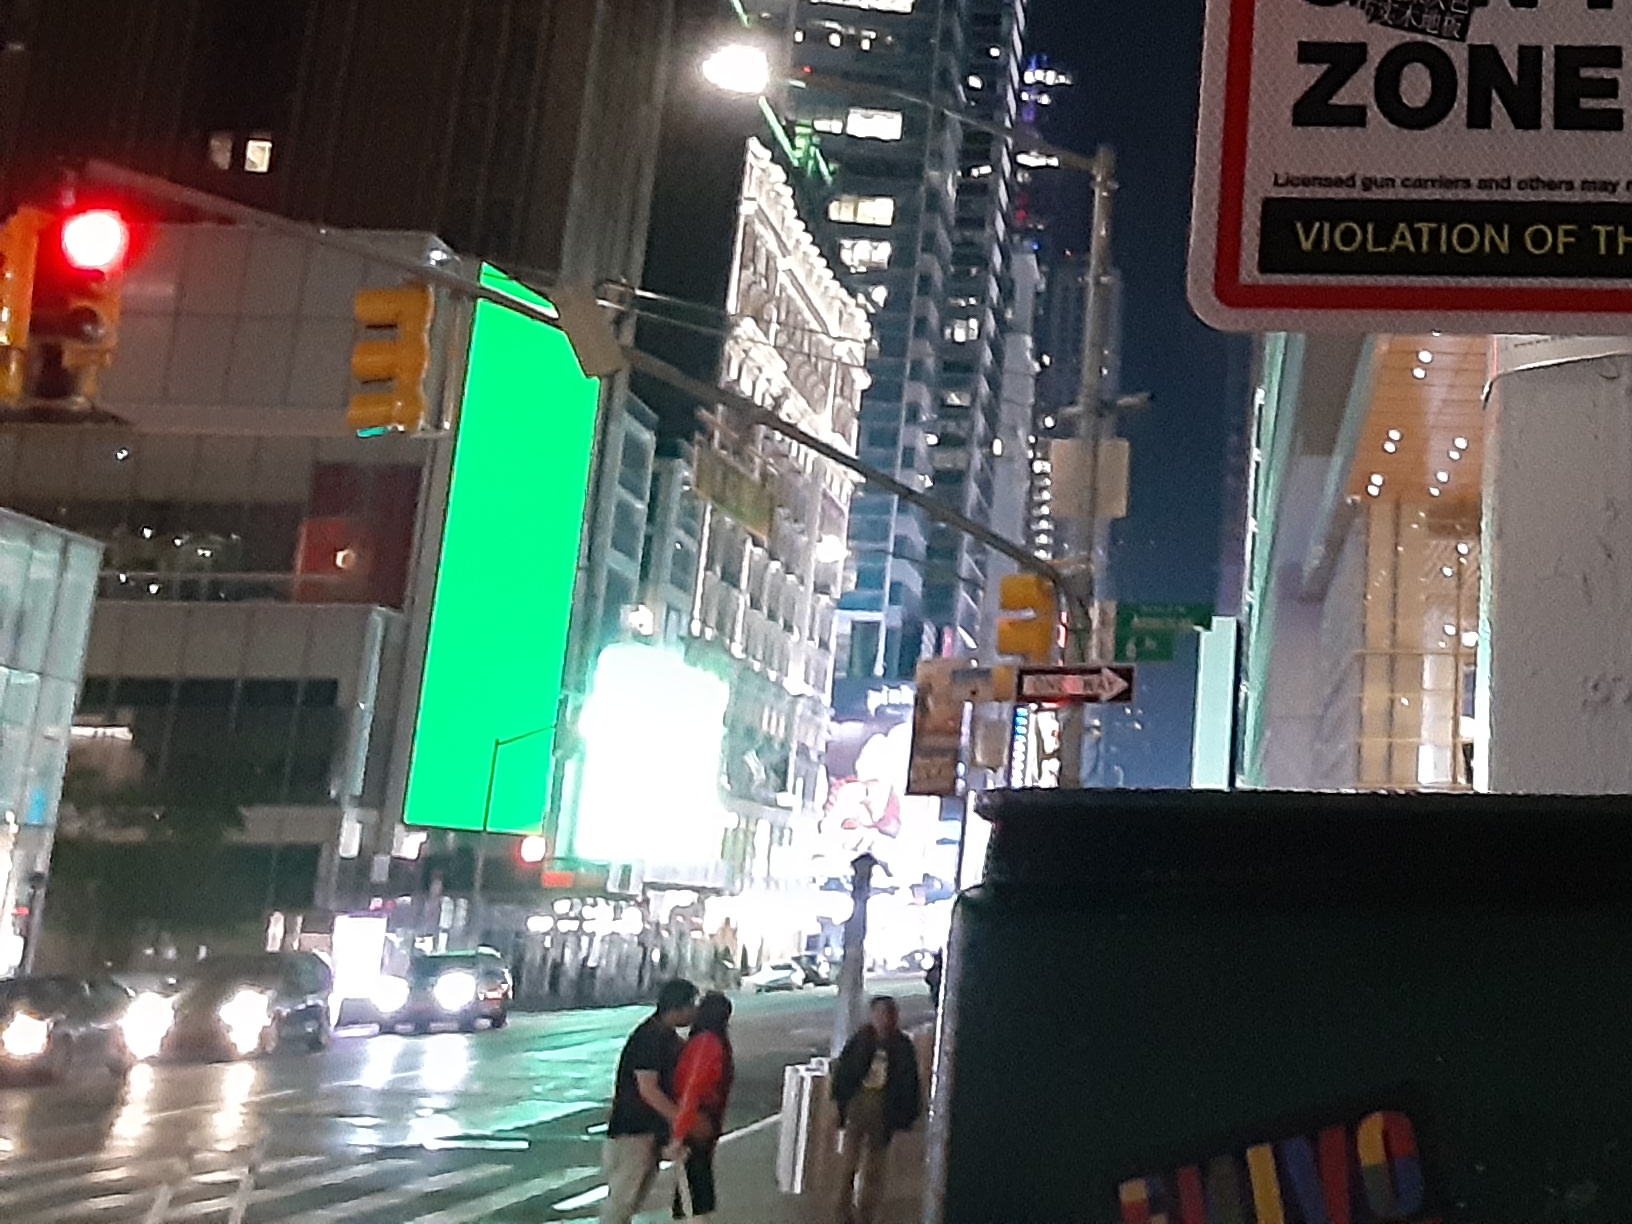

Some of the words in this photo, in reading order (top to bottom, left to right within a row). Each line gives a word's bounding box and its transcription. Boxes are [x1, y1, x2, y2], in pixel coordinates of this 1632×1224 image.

[1292, 41, 1625, 133] ZONE
[1272, 171, 1356, 189] Licensed
[1361, 176, 1396, 192] gun
[1400, 174, 1471, 191] carriers
[1477, 175, 1511, 191] and
[1516, 175, 1575, 192] others
[1580, 179, 1619, 195] may
[1295, 221, 1509, 255] VIOLATION
[1524, 224, 1577, 256] OF
